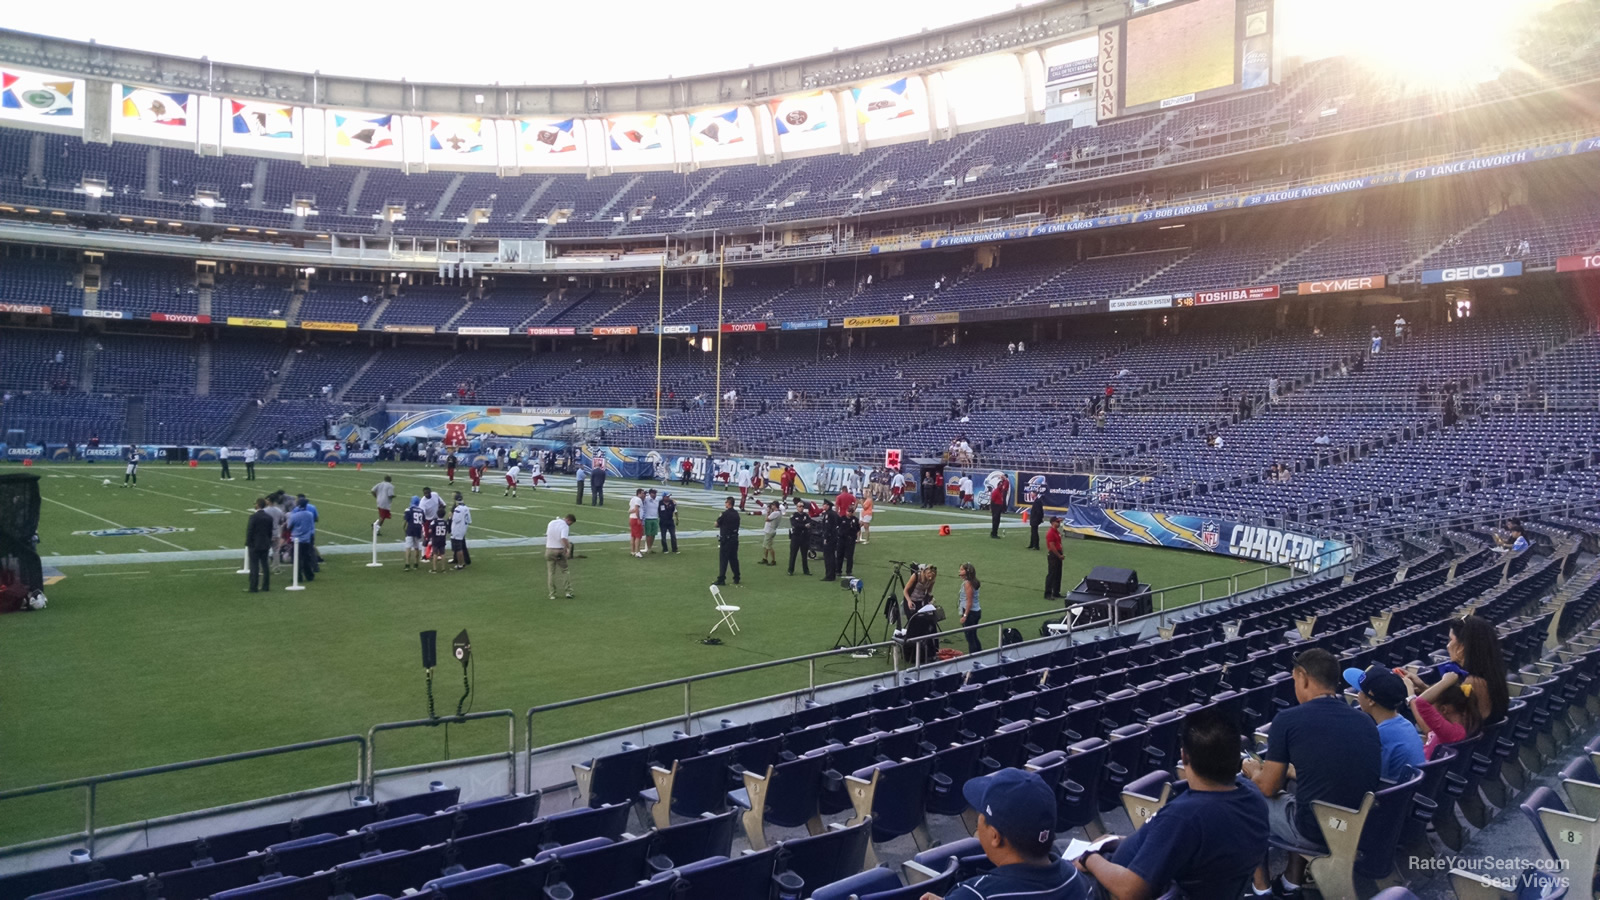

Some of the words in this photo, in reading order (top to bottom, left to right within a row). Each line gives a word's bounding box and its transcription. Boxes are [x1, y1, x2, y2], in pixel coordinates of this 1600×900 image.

[1101, 31, 1114, 117] SYCUAN
[1415, 169, 1426, 179] 19
[1431, 162, 1465, 177] LANCE
[1468, 151, 1526, 170] ALWORTH
[1251, 196, 1261, 205] 38
[1264, 188, 1301, 203] JACQUE
[1301, 179, 1364, 197] MacKINNON
[1144, 211, 1153, 220] 53
[1156, 208, 1173, 218] BOB
[1174, 203, 1208, 216] LARABA
[1038, 227, 1045, 235] 56
[1048, 224, 1066, 233] EMIL
[1067, 220, 1093, 231] KARAS
[941, 238, 949, 246] 55
[950, 235, 974, 245] FRANK
[974, 231, 1006, 243] BUNCOM
[1441, 263, 1504, 283] GEICO
[1310, 278, 1372, 293] CYMER
[1199, 289, 1248, 302] TOSHIBA
[82, 309, 123, 319] GEICO
[164, 314, 199, 323] TOYOTA
[663, 325, 691, 334] GEICO
[86, 448, 117, 456] CHARGERS
[413, 512, 423, 525] 93
[435, 525, 446, 536] 85
[1203, 533, 1217, 548] NFL
[1229, 524, 1325, 573] CHARGERS
[1336, 819, 1342, 830] 7
[1567, 831, 1575, 843] 8
